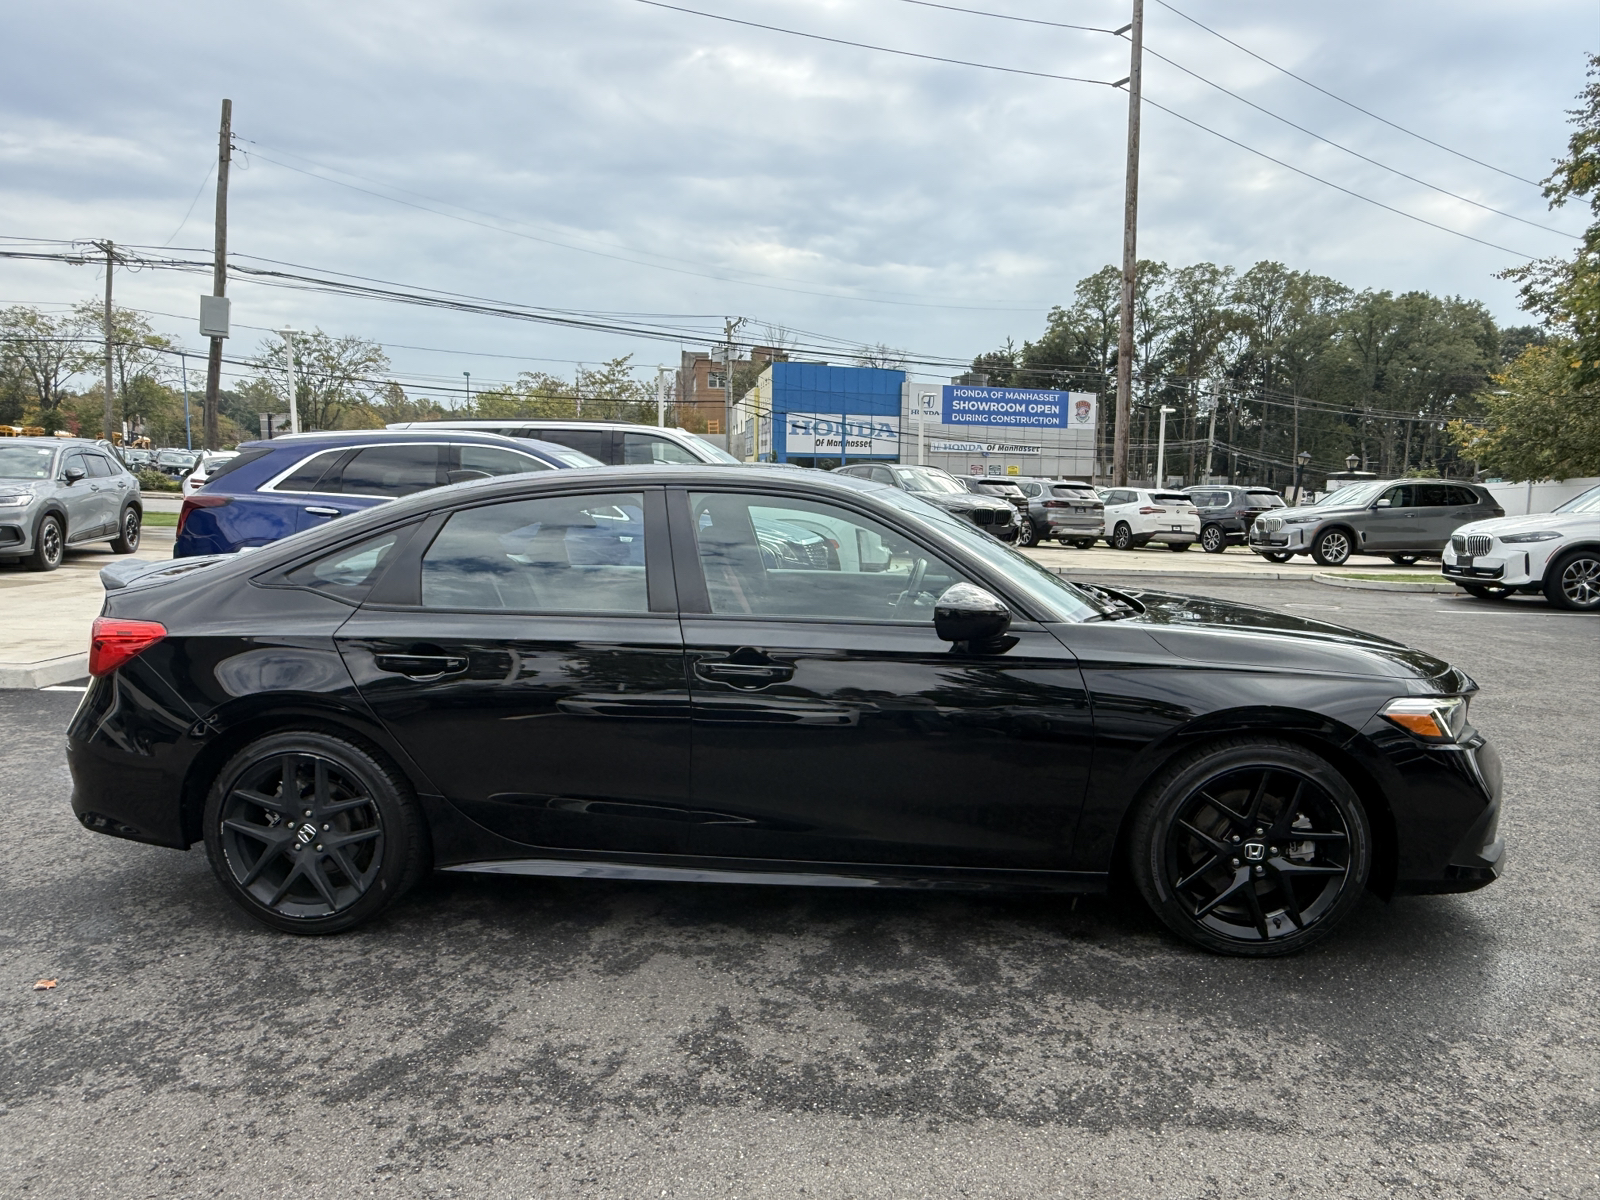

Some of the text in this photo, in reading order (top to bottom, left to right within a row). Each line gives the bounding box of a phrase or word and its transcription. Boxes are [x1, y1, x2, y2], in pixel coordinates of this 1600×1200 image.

[953, 388, 1060, 402] HONDA OF MANHASSET
[952, 400, 1060, 414] SHOWROOM OPEN
[951, 413, 1060, 425] DURING CONSTRUCTION
[788, 420, 897, 438] HONDA
[826, 439, 873, 448] Manhasset
[943, 443, 983, 451] HONDA
